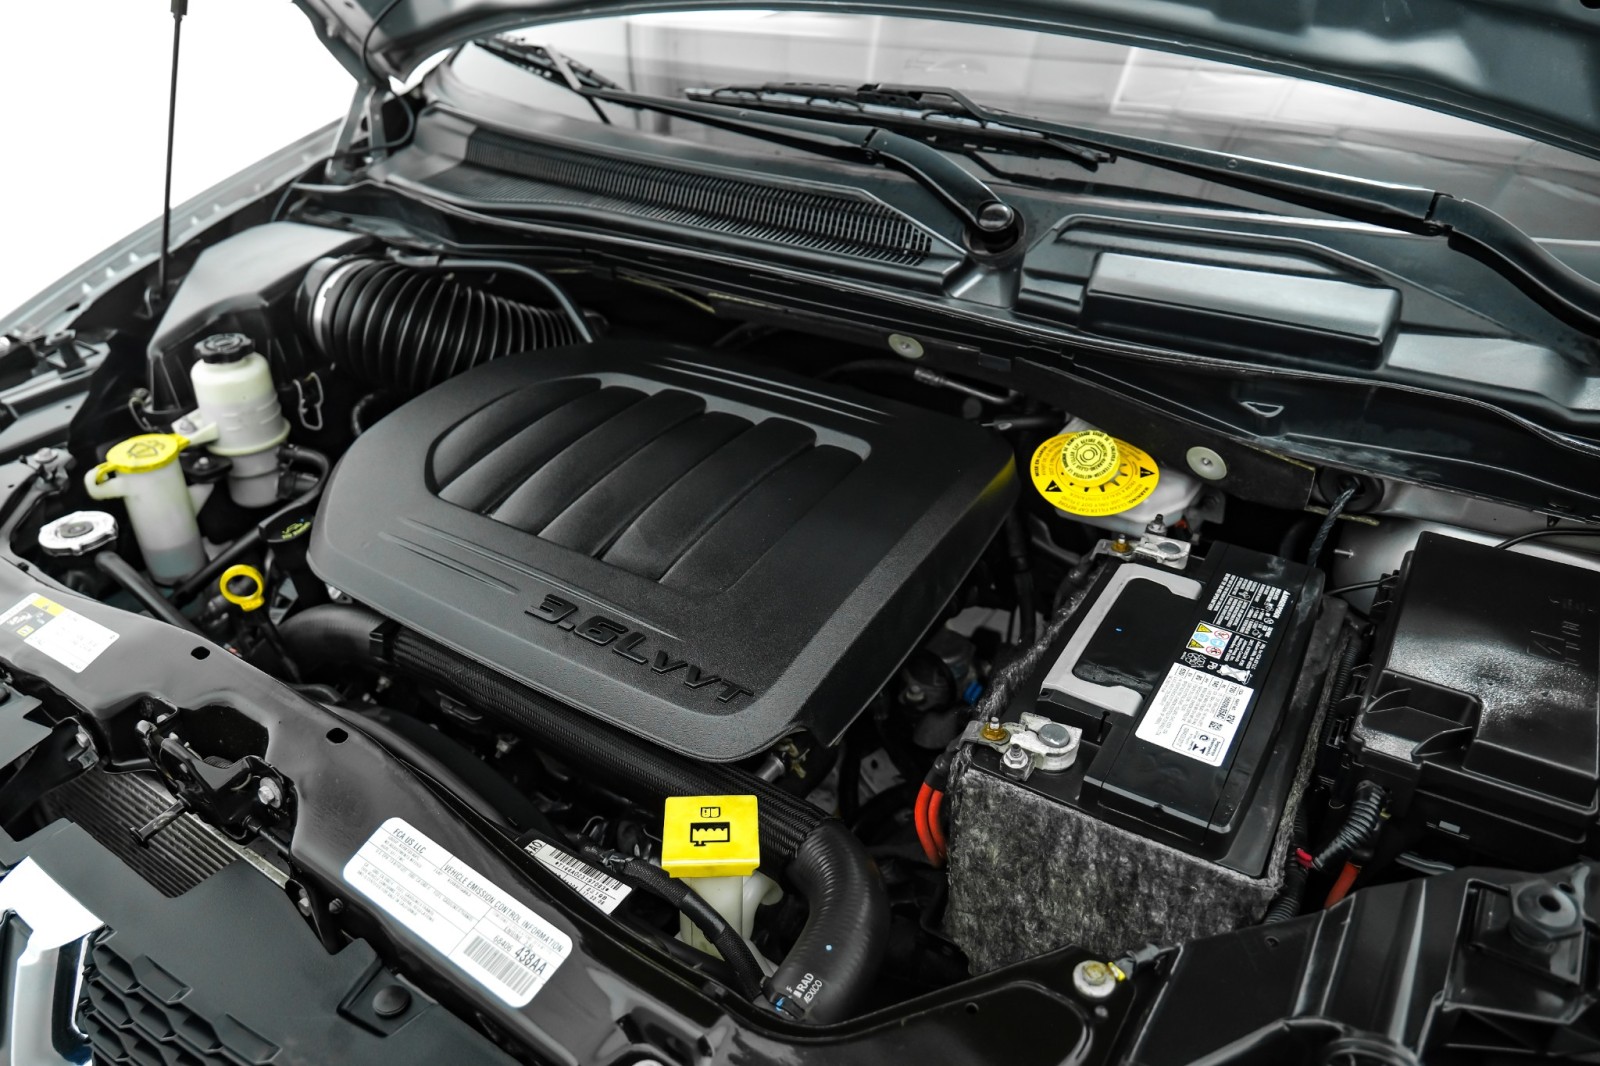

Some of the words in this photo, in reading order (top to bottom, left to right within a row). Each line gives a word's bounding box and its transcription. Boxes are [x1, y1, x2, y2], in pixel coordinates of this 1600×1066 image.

[392, 827, 405, 840] FCA
[403, 835, 415, 846] US
[412, 842, 426, 854] LLC
[443, 864, 468, 884] VEHICLE
[466, 880, 495, 904] EMISSION
[494, 900, 522, 923] CONTROL
[520, 919, 564, 952] INFORMATION
[492, 934, 514, 952] 68406
[512, 945, 548, 975] 438AA
[797, 972, 814, 992] RAD
